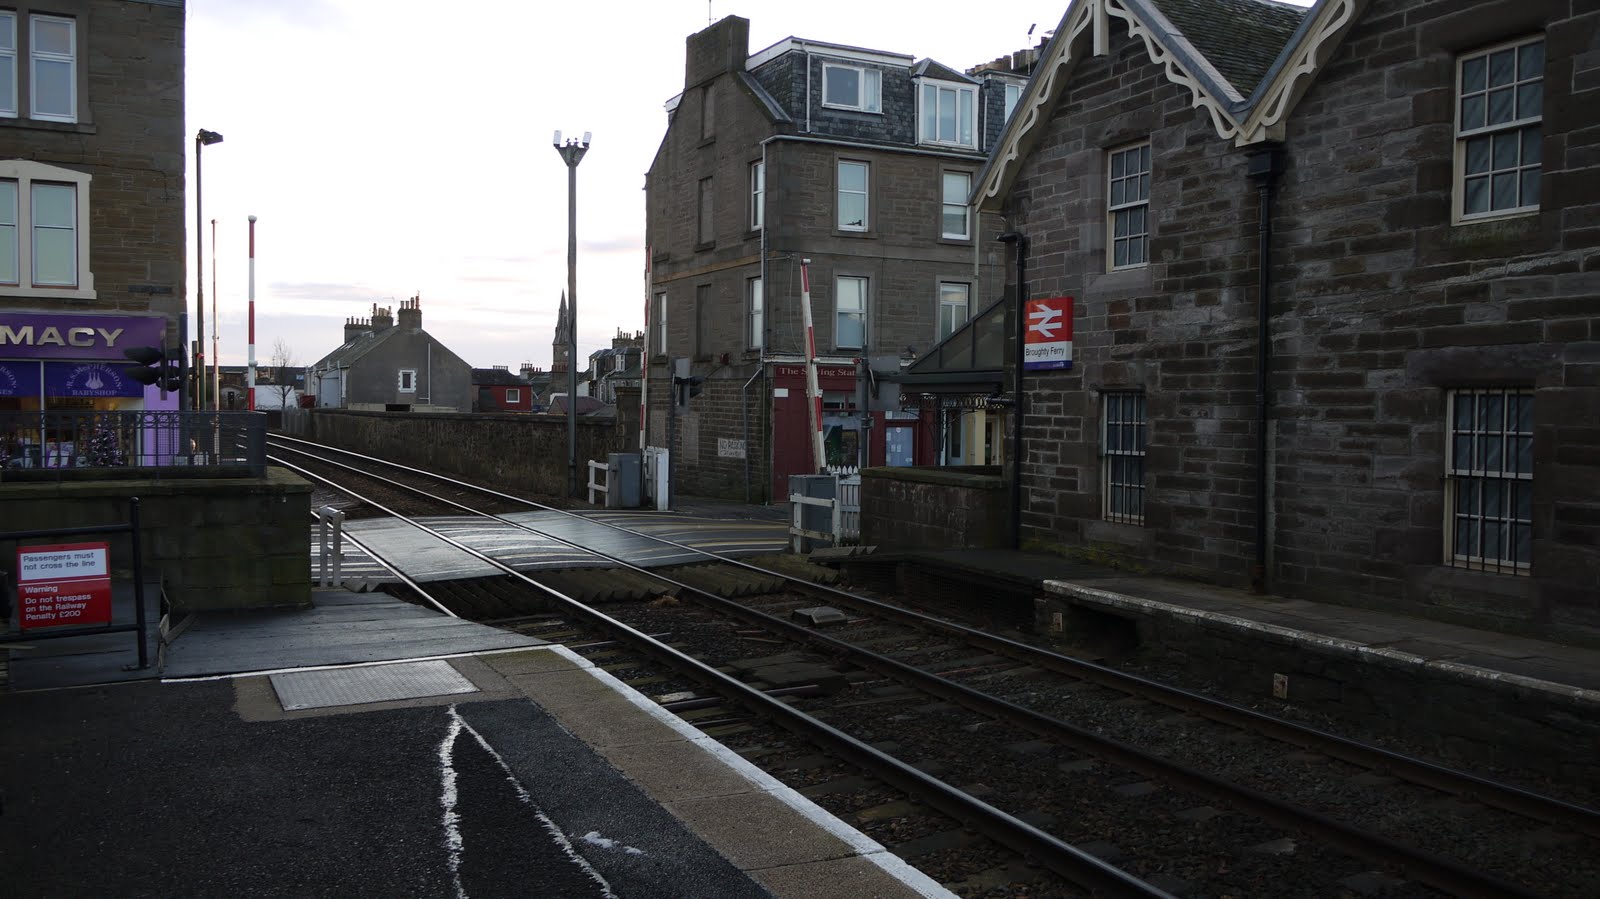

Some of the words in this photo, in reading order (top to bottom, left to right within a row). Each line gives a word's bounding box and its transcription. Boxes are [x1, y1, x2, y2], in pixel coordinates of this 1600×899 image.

[0, 325, 124, 347] MACY
[1026, 348, 1049, 357] Broughty
[1050, 347, 1064, 356] Ferry
[779, 367, 798, 375] The
[23, 554, 71, 562] Passengers
[25, 586, 58, 594] Warning
[56, 594, 91, 602] trespass
[55, 603, 87, 611] Railway
[26, 613, 57, 621] Penalty
[59, 610, 81, 618] £200
